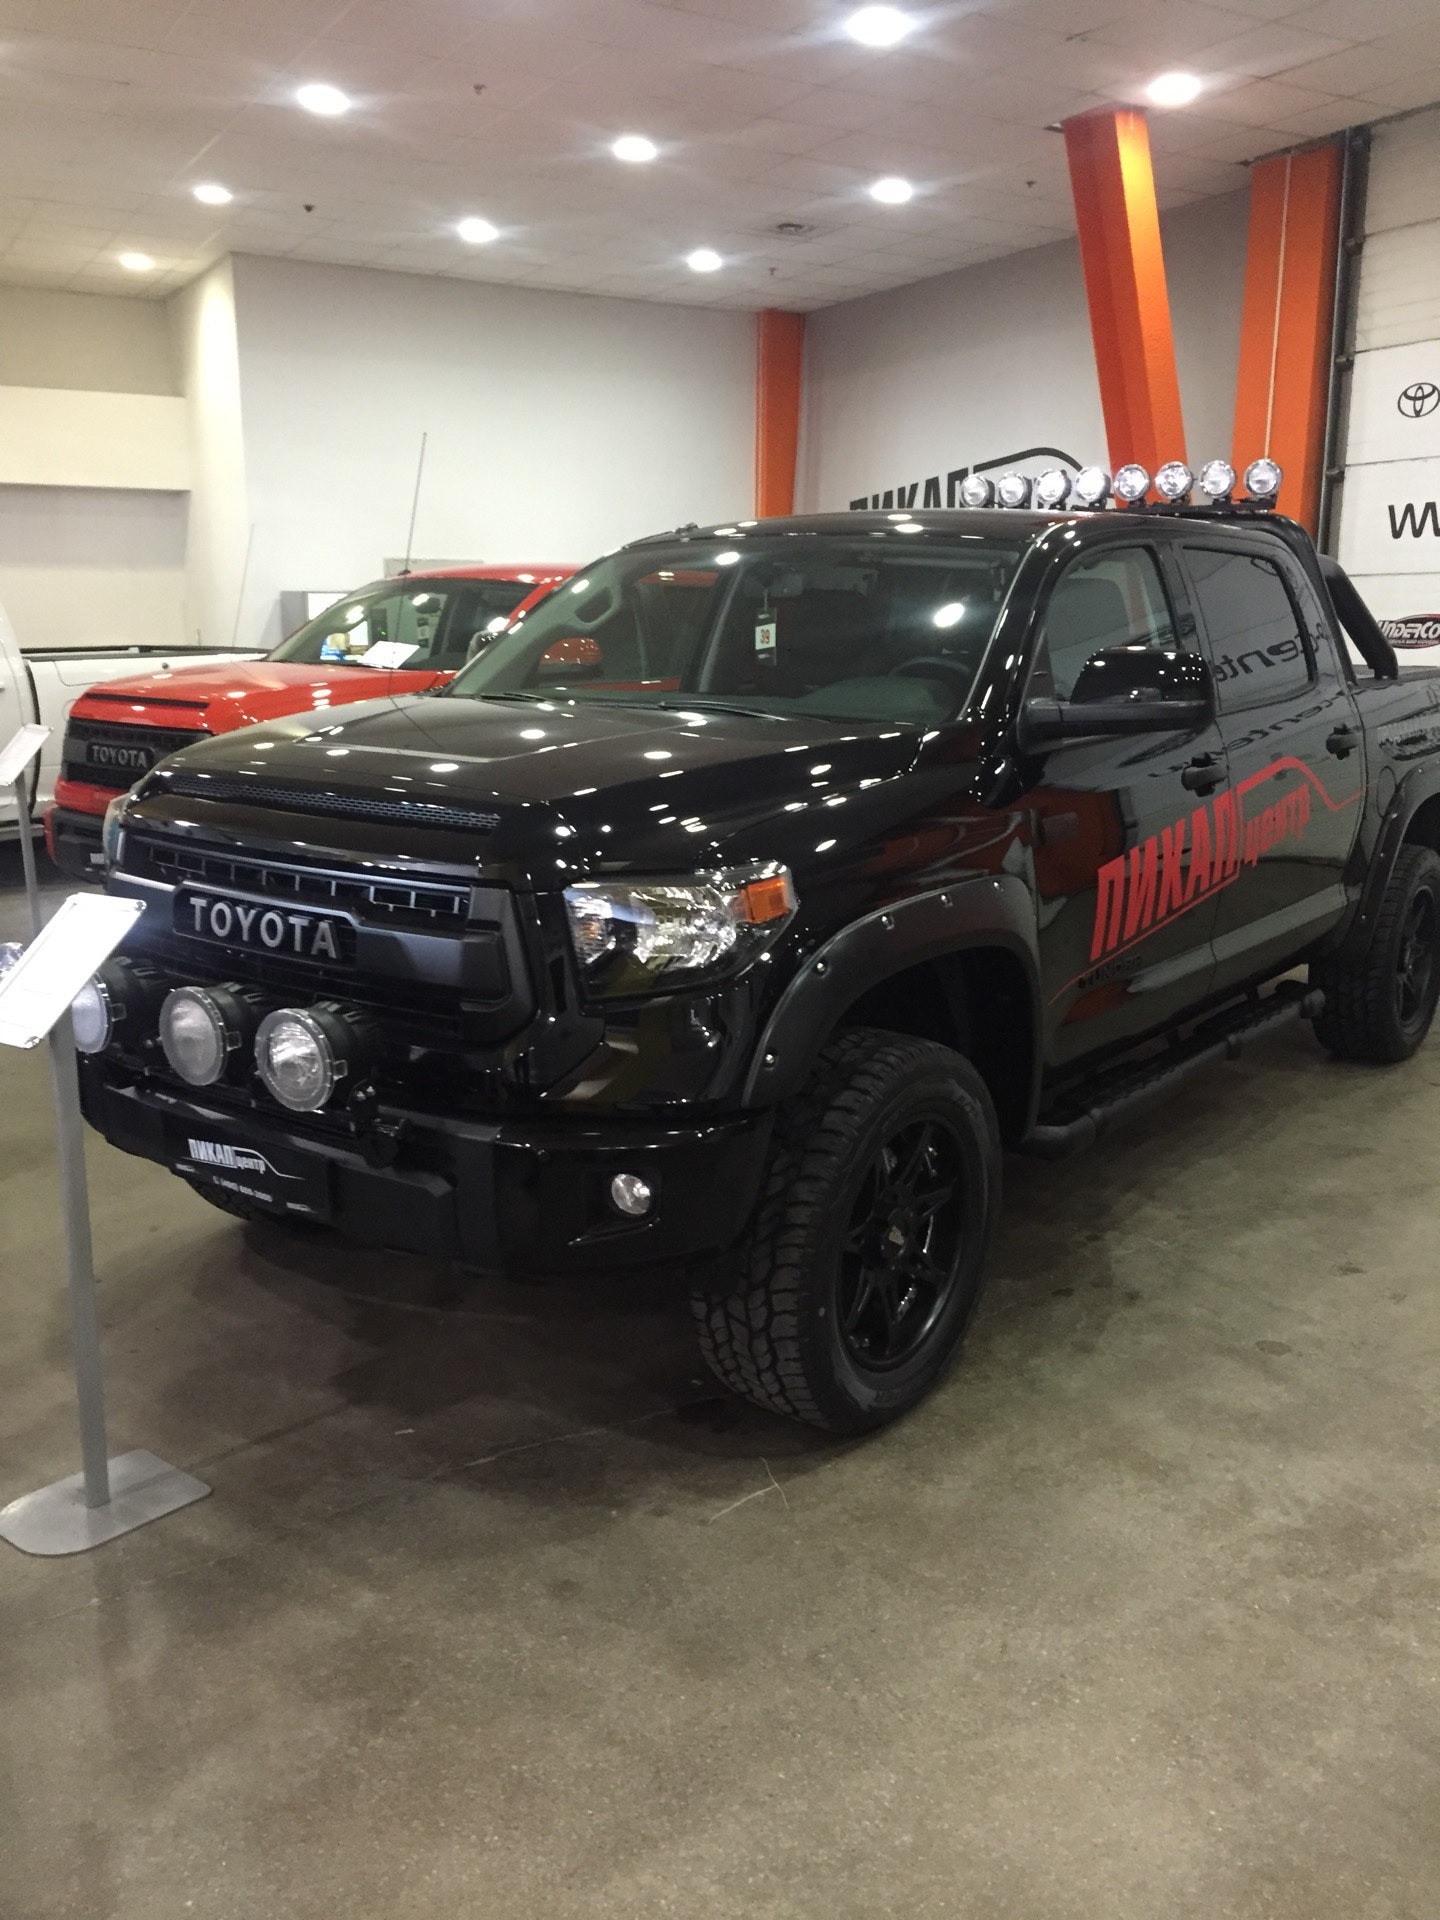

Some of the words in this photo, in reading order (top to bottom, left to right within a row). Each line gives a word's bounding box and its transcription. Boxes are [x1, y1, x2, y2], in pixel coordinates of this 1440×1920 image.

[91, 745, 148, 768] TOYOTA
[1090, 789, 1237, 962] ПИКАП
[190, 897, 339, 959] TOYOTA
